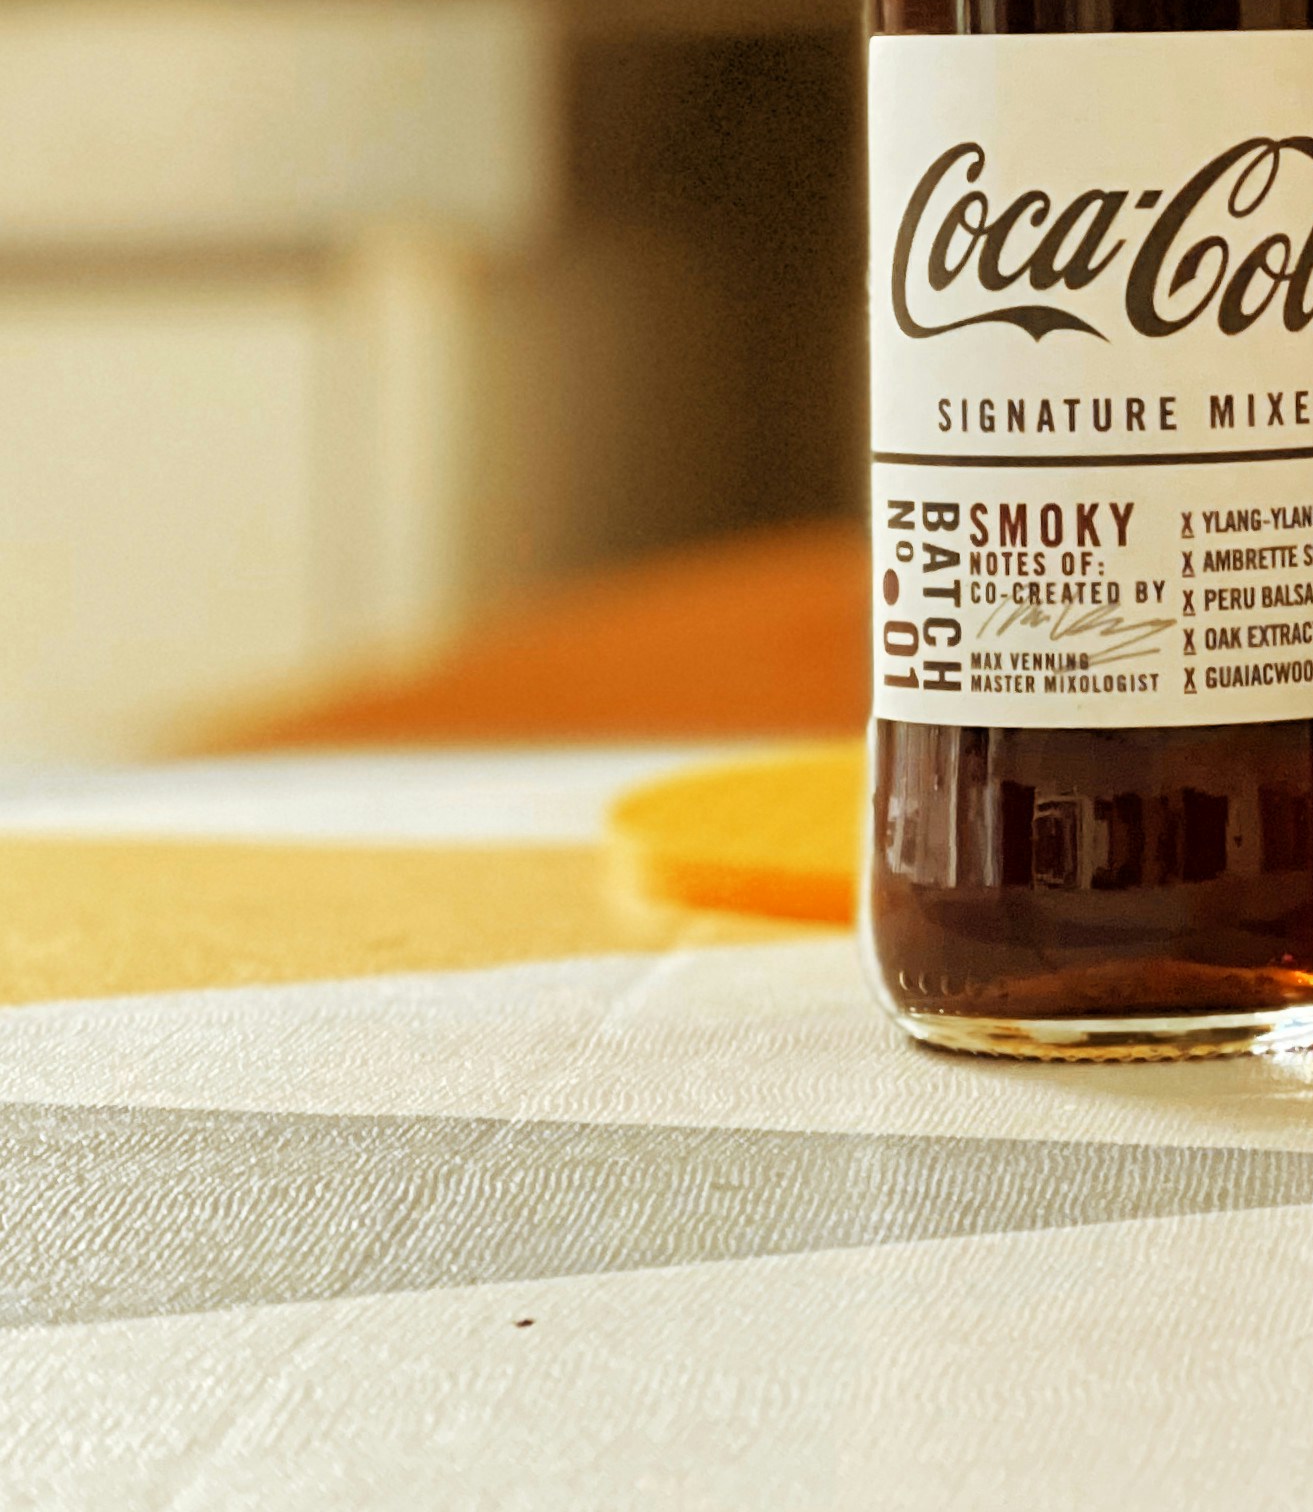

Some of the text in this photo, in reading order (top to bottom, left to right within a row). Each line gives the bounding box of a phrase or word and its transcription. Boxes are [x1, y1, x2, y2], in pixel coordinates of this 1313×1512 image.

[938, 396, 1178, 434] SIGNATURE
[969, 502, 1134, 548] SMOKY
[969, 551, 1105, 577] NOTES OF:
[1202, 544, 1298, 573] AMBRETTE
[922, 501, 962, 692] BATCH
[970, 580, 1166, 605] CO-CREATED BY
[1204, 587, 1255, 612] PERU
[1205, 627, 1242, 651] OAK
[883, 620, 920, 690] 01
[971, 652, 1089, 671] MAX VENNING
[970, 673, 1159, 693] MASTER MIXOLOGIST
